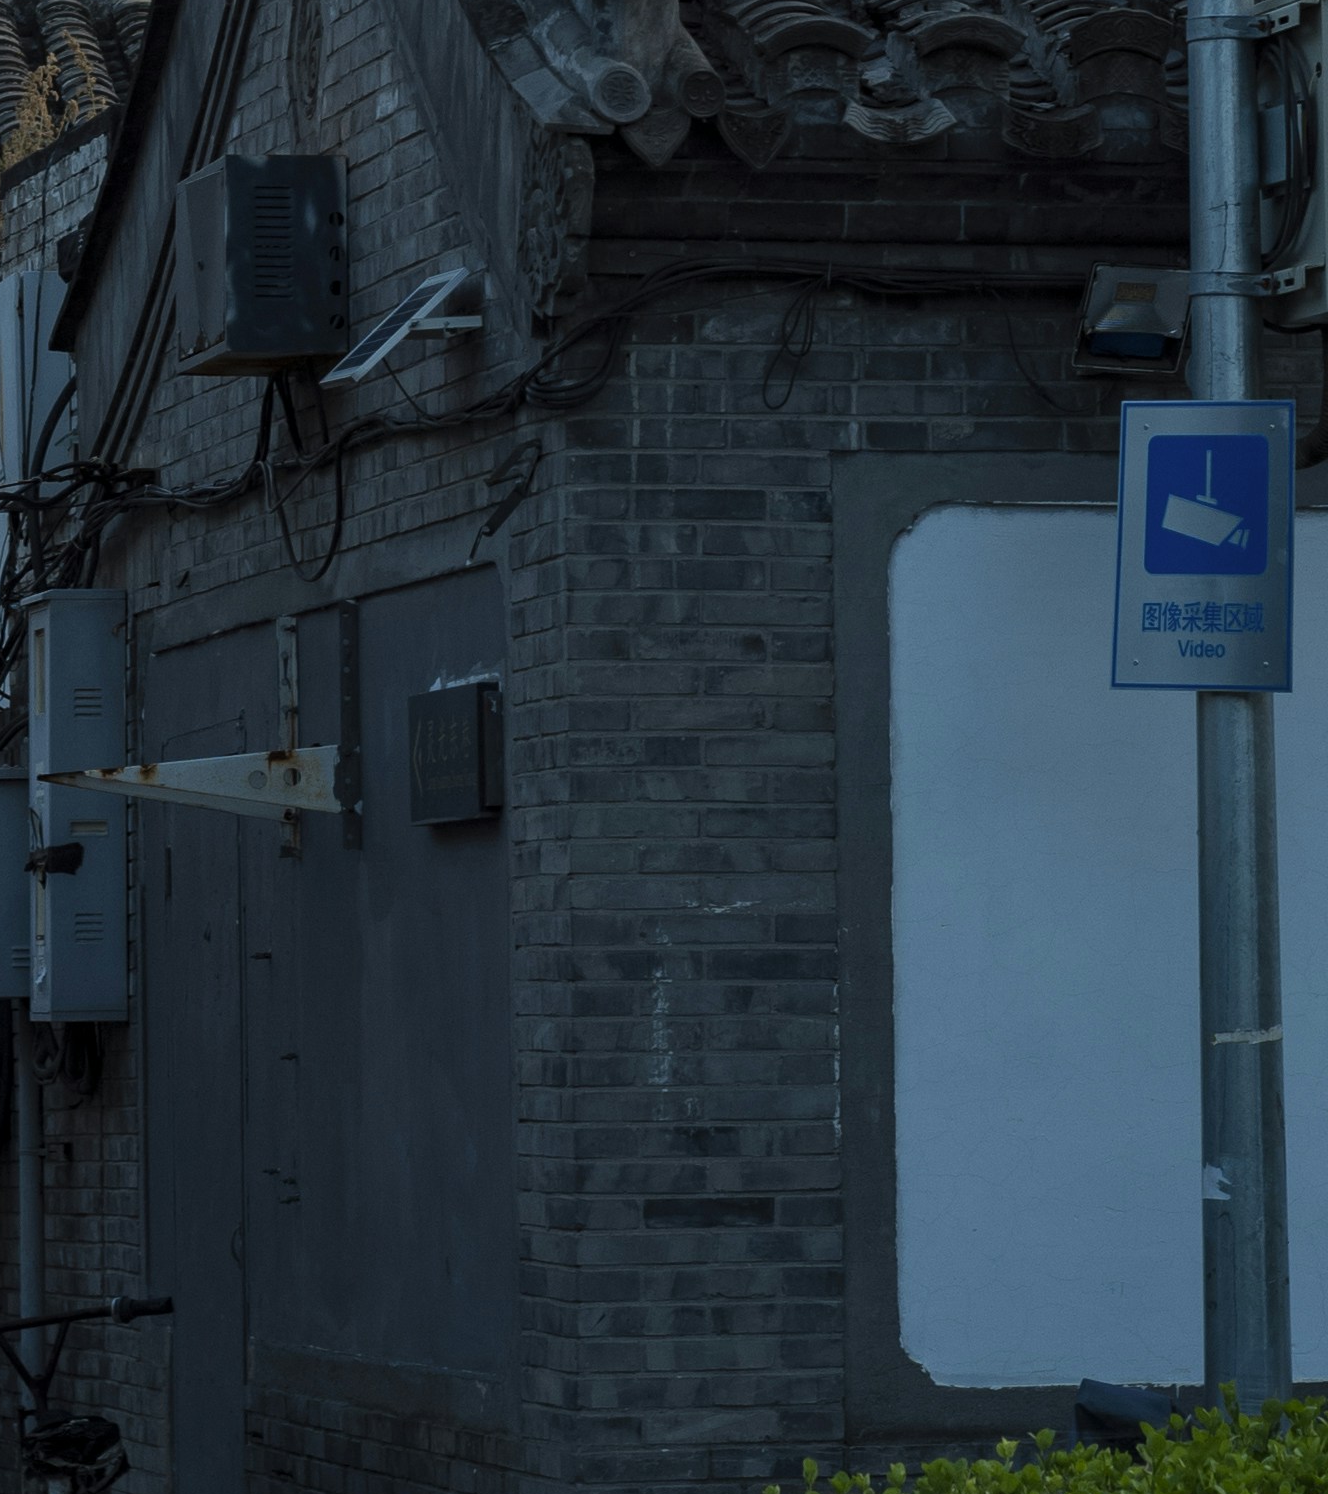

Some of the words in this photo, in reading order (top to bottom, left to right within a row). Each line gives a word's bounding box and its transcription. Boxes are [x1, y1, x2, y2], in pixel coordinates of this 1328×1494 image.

[1142, 600, 1264, 633] 图像采集区域
[1177, 639, 1225, 658] Video
